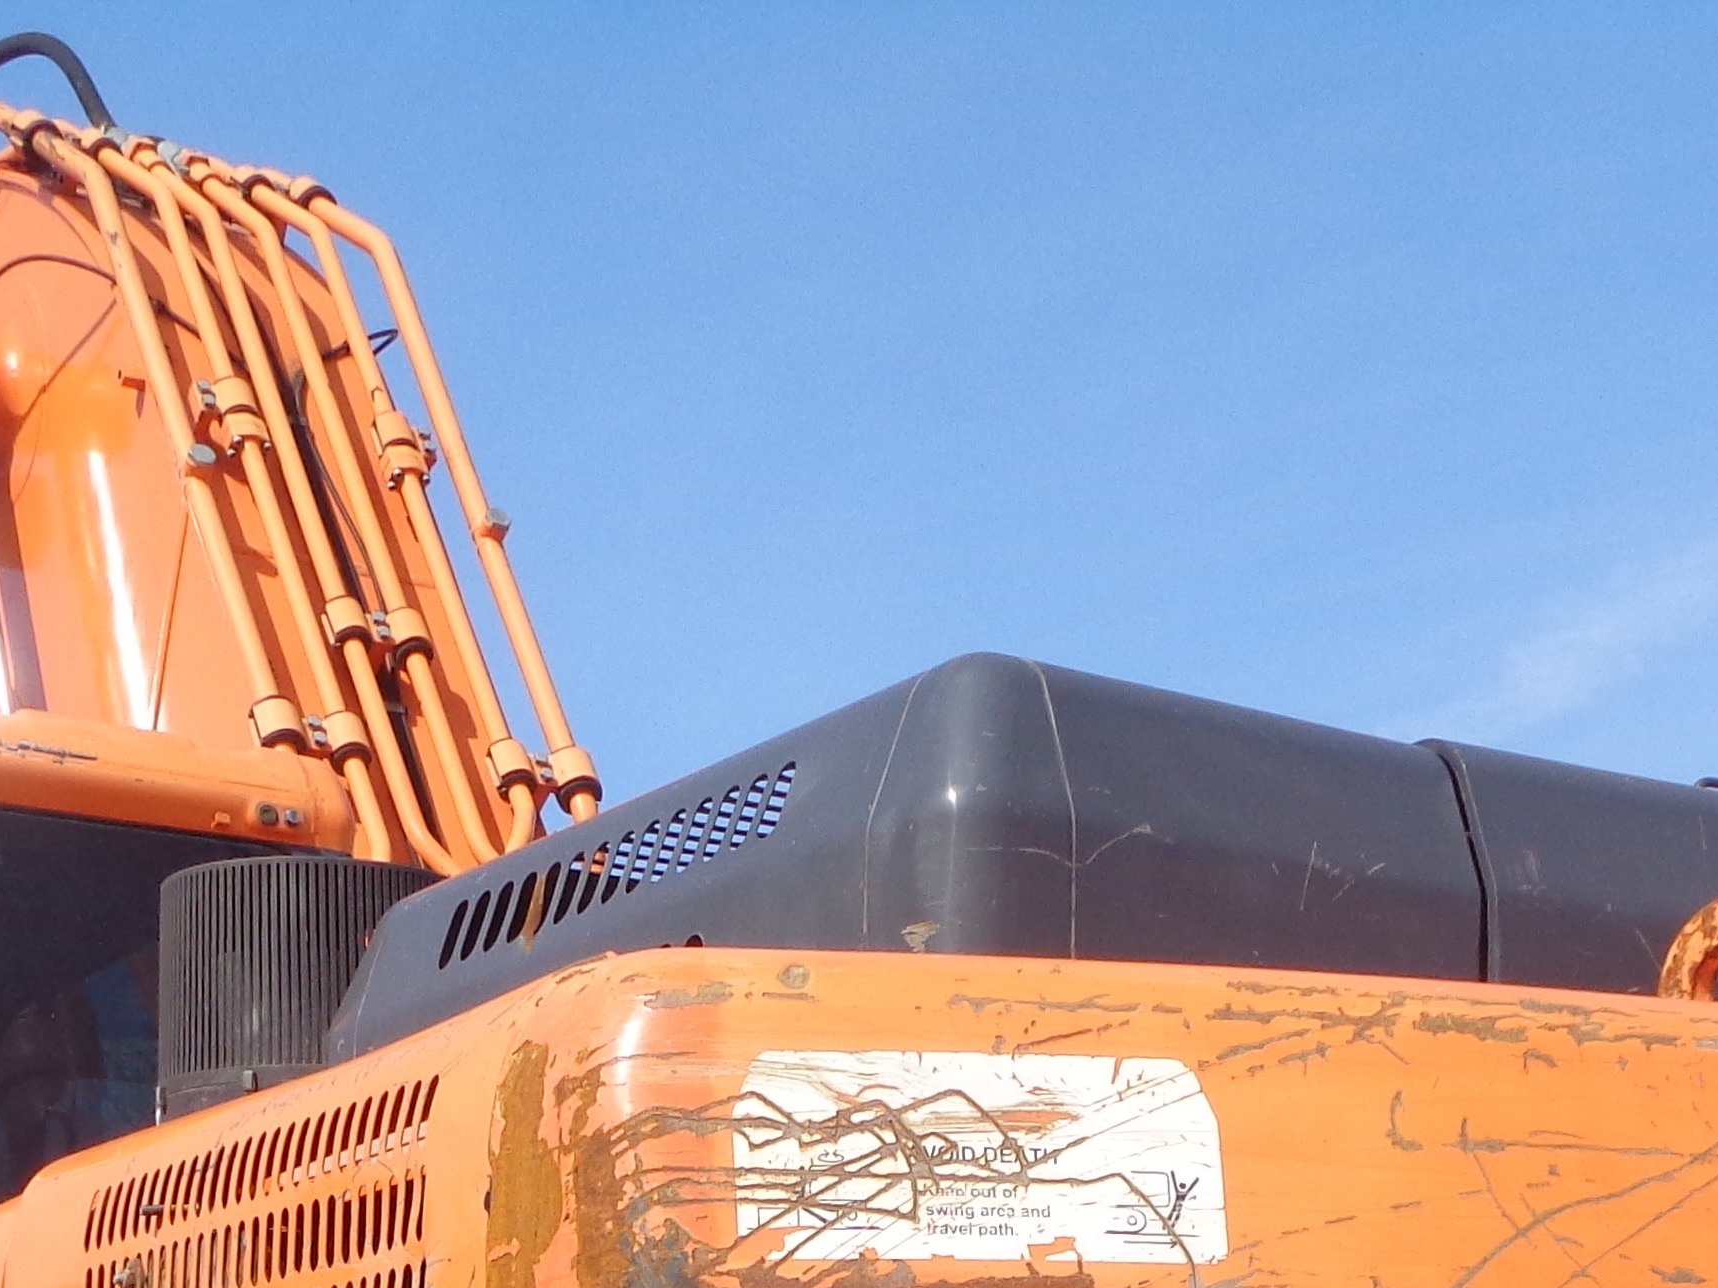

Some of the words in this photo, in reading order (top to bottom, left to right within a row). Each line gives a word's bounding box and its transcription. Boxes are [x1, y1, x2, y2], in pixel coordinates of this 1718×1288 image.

[970, 1185, 997, 1199] out
[1002, 1184, 1019, 1199] of
[926, 1204, 975, 1220] swing
[1021, 1204, 1051, 1219] and
[927, 1222, 973, 1236] travel
[978, 1222, 1019, 1237] path.
